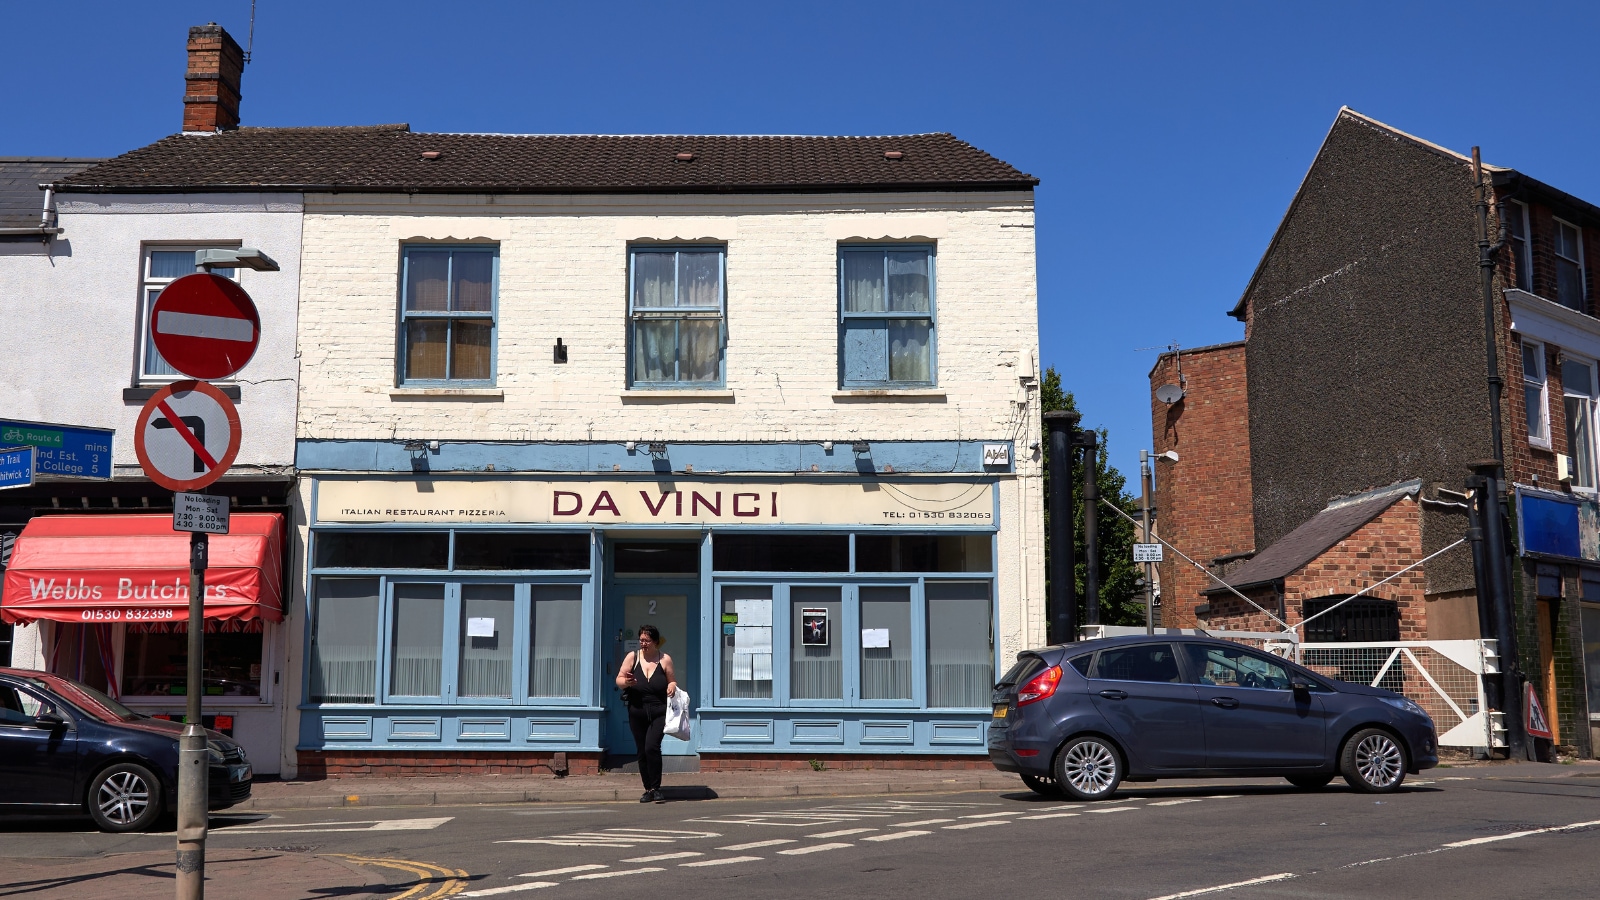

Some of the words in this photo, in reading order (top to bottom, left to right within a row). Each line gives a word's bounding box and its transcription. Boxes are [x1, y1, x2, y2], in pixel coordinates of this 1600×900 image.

[26, 432, 52, 442] Route
[52, 435, 60, 443] 4
[84, 442, 108, 452] mins
[7, 454, 21, 465] Trail
[37, 449, 56, 460] Ind.
[59, 451, 79, 461] Est.
[92, 454, 99, 463] 3
[43, 460, 83, 473] College
[91, 464, 98, 473] 5
[0, 469, 22, 481] hitwick
[25, 468, 30, 478] 2
[196, 496, 221, 505] loading
[552, 490, 621, 516] DA
[639, 490, 778, 517] VINCI
[206, 506, 218, 514] Sat
[385, 508, 454, 516] RESTAURANT
[197, 542, 205, 550] S
[197, 551, 203, 560] 1
[29, 577, 103, 600] Webbs
[117, 577, 227, 600] Butchrs
[648, 600, 657, 615] 2
[81, 609, 121, 620] 01530
[125, 608, 173, 620] 832398
